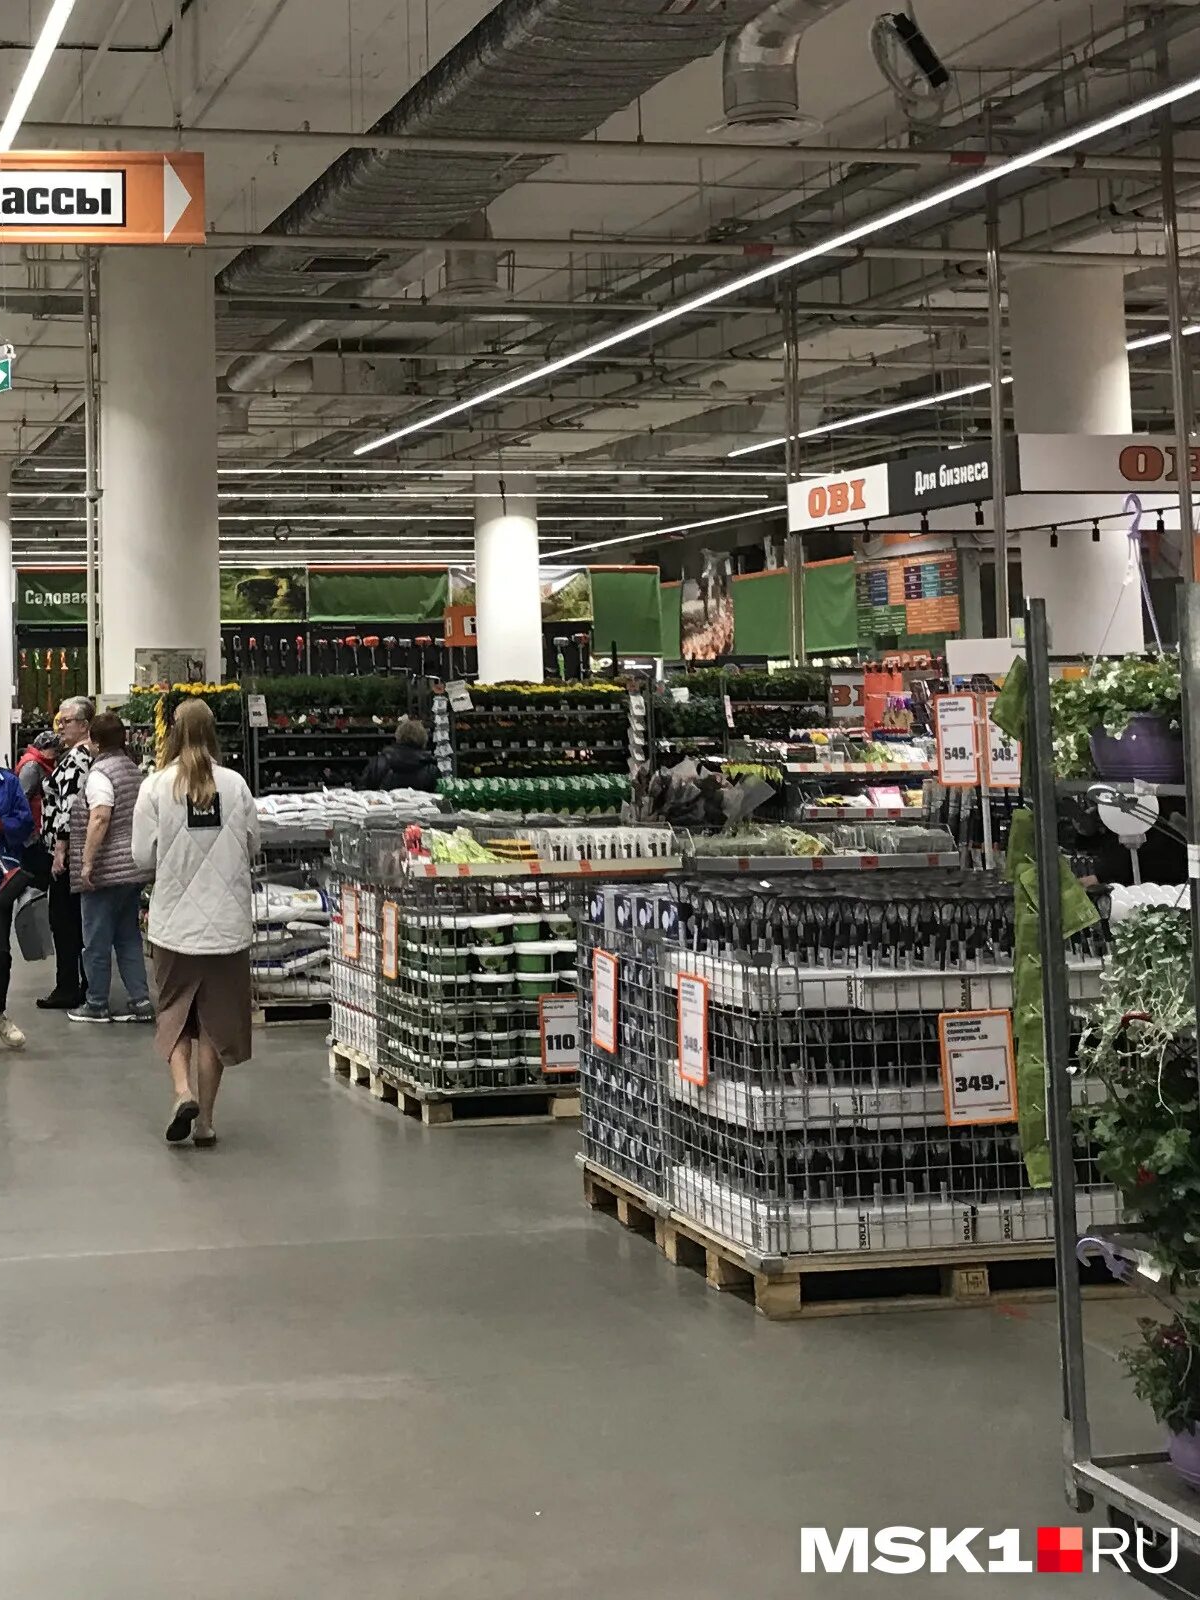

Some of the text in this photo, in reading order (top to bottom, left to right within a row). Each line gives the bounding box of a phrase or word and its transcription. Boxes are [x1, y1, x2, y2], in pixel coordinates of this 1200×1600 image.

[914, 461, 988, 496] Для бизнеса
[808, 479, 866, 518] OBI
[25, 589, 88, 607] Садовая
[546, 1034, 575, 1050] 110
[955, 1075, 1006, 1092] 349,-
